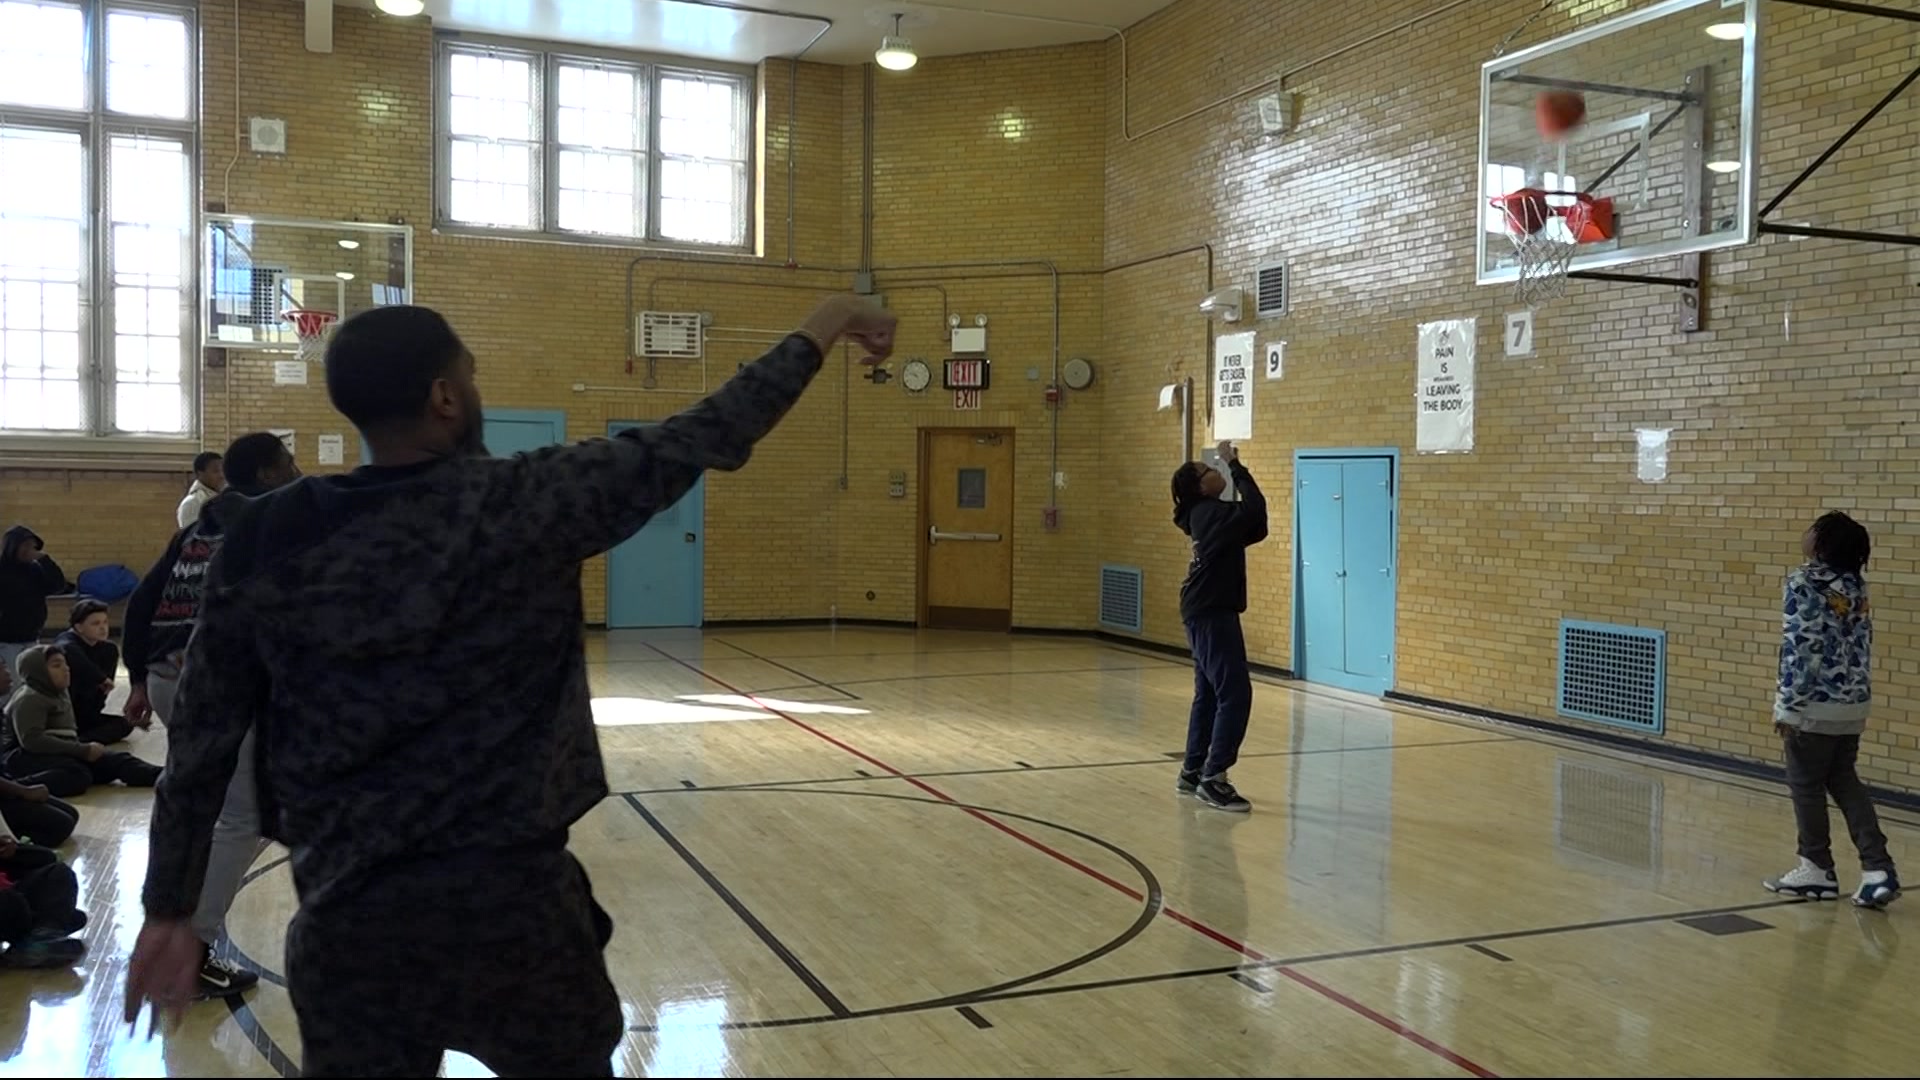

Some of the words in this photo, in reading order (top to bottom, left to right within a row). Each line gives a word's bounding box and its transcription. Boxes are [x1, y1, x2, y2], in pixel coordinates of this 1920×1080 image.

[1512, 320, 1526, 348] 7
[1435, 347, 1454, 359] PAIN
[1270, 351, 1279, 372] 9
[1441, 362, 1448, 374] IS
[953, 362, 978, 383] EXIT
[956, 389, 978, 408] EXIT
[1426, 384, 1461, 397] LEAVING
[1423, 401, 1438, 412] THE
[1440, 399, 1463, 411] BODY
